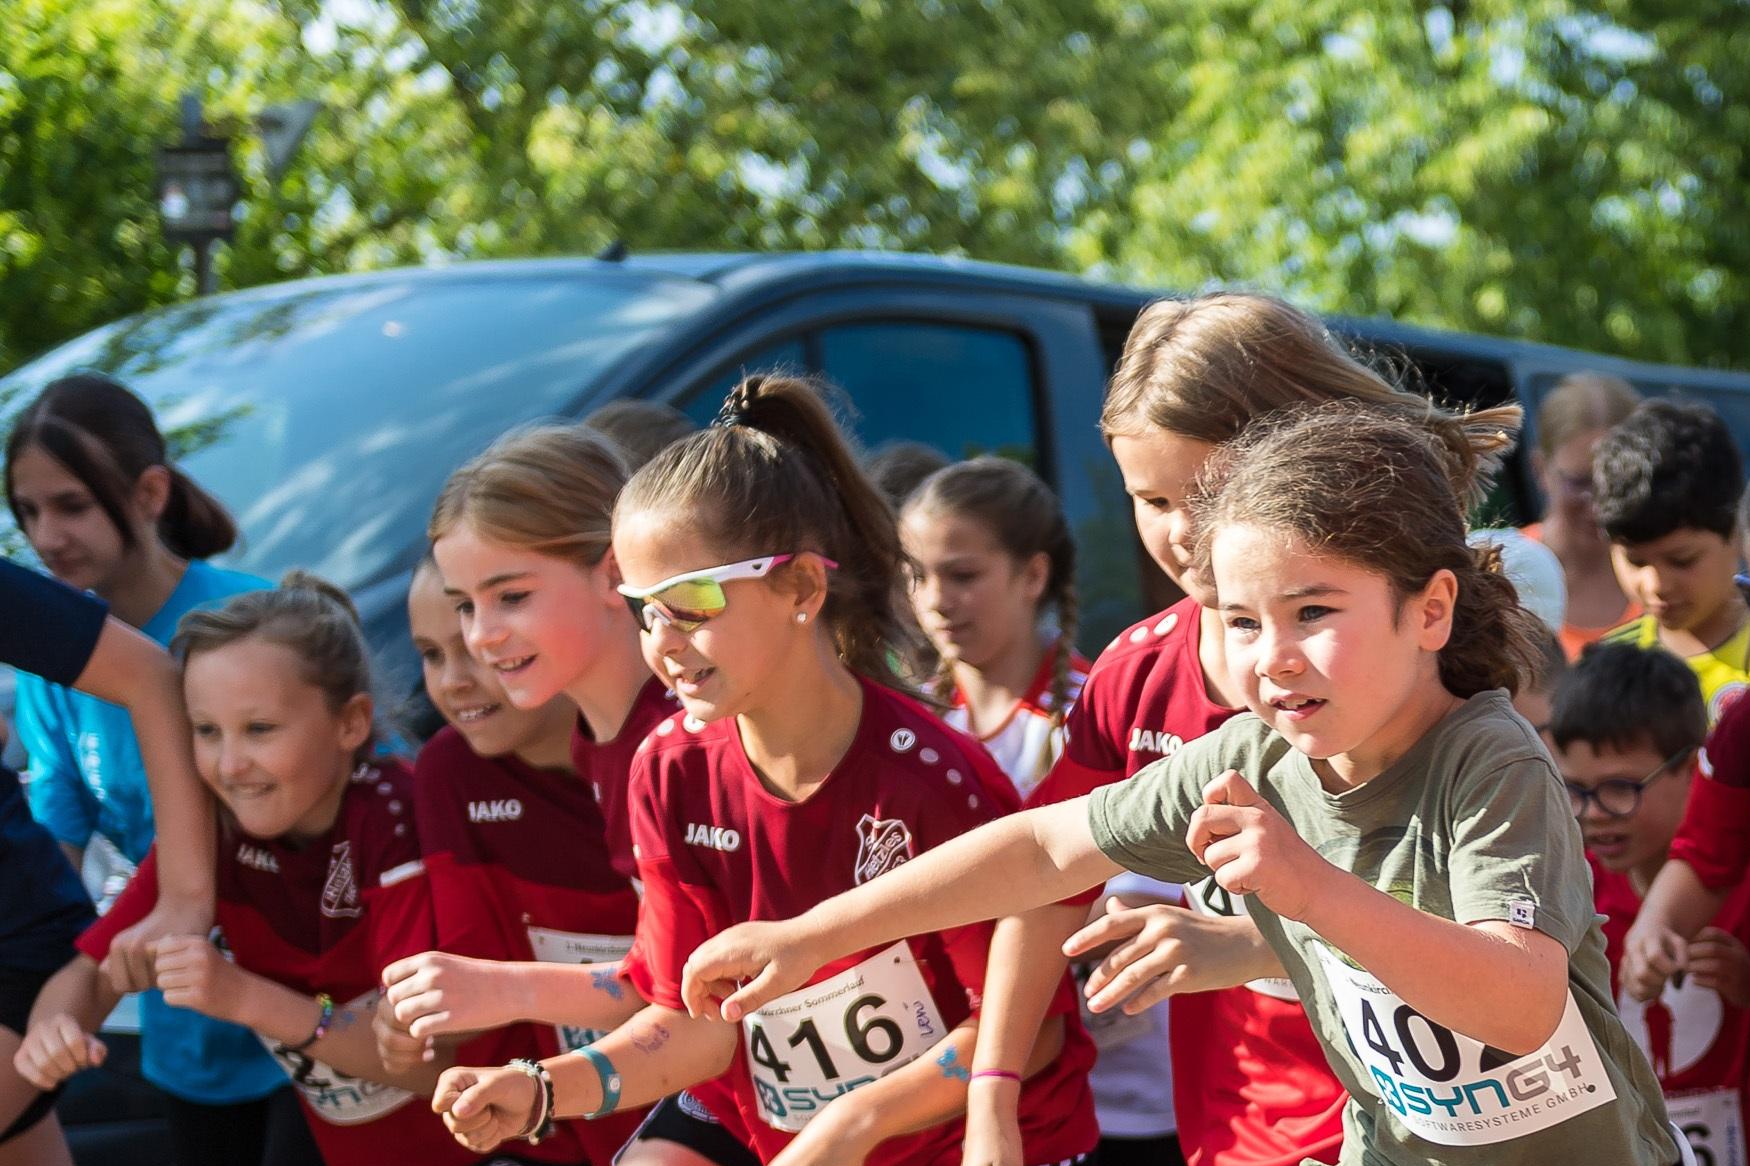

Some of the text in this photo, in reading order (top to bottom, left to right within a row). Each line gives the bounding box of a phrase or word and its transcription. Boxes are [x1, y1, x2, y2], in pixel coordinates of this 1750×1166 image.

[1128, 727, 1184, 757] JAKO
[467, 798, 523, 823] JAKO
[684, 822, 740, 852] JAKO
[803, 974, 866, 1009] Sommerlauf
[750, 993, 904, 1083] 416
[1361, 997, 1524, 1083] 40
[1546, 1082, 1590, 1109] GMBH
